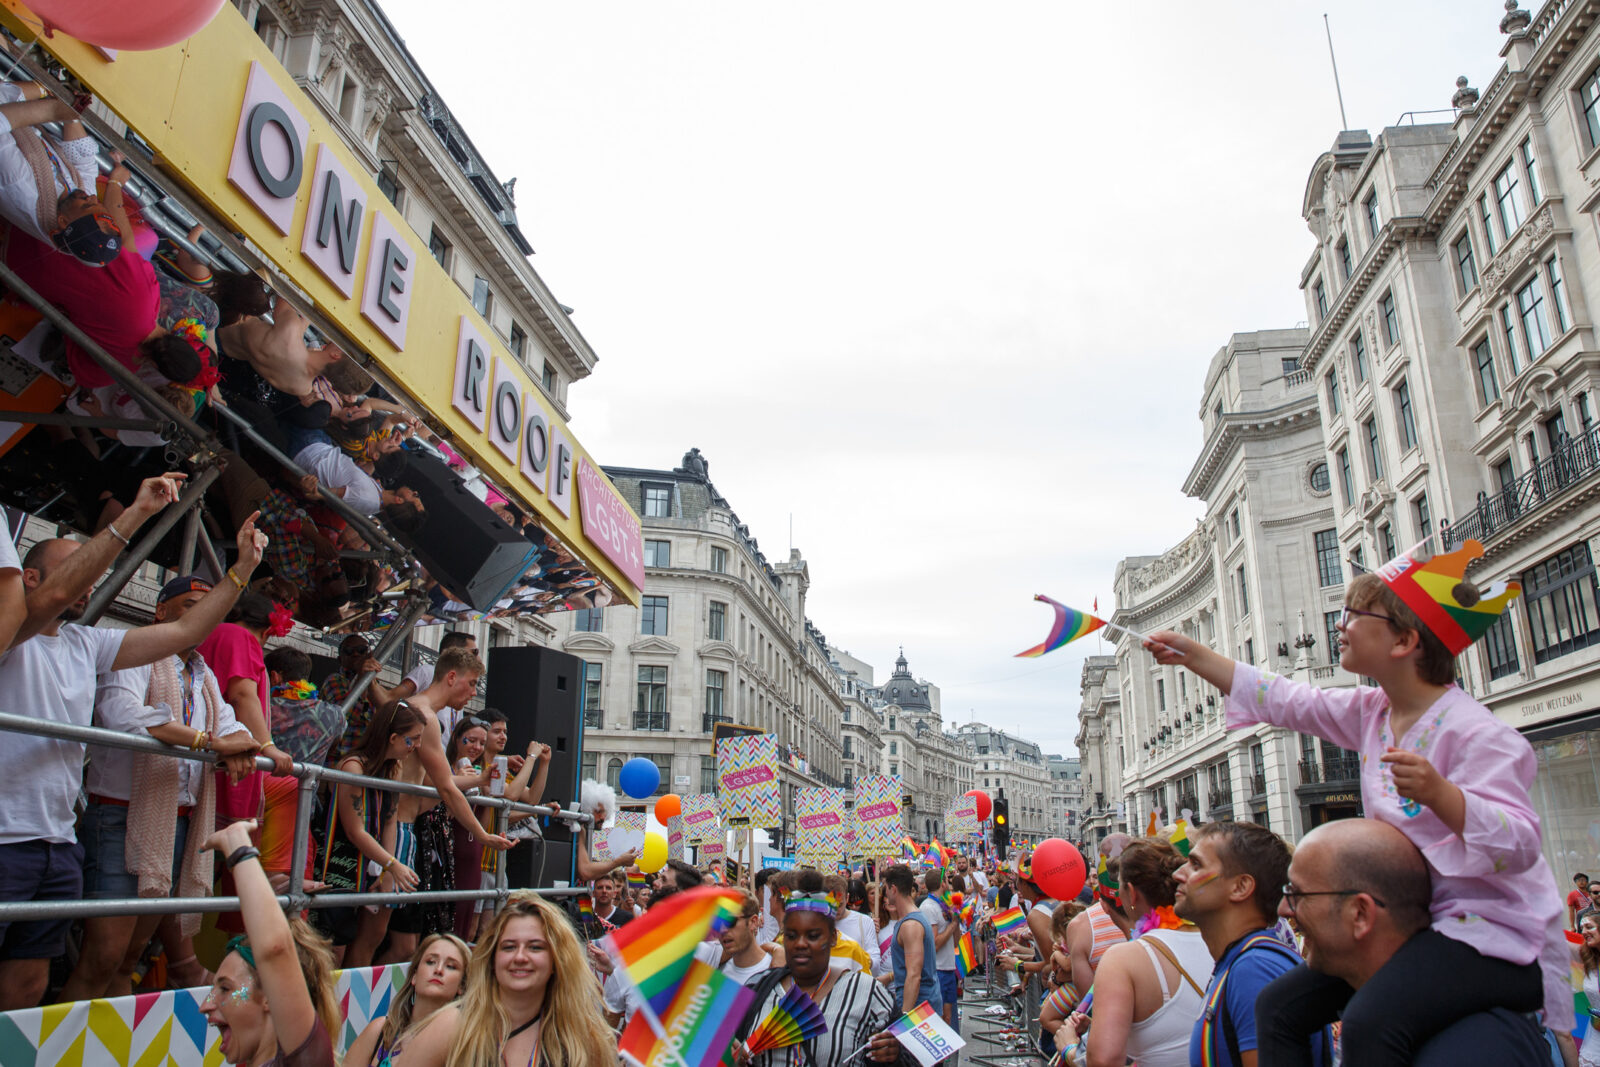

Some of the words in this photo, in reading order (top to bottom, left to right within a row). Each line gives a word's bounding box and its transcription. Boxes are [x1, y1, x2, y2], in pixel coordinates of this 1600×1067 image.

[247, 101, 408, 323] ONE
[464, 338, 570, 495] ROOF
[581, 465, 639, 540] ARCHITECTURE
[1521, 702, 1544, 717] STUART
[1545, 692, 1583, 711] WEITZMAN
[726, 772, 768, 788] LGBT+
[668, 984, 713, 1036] Tinto
[917, 1022, 954, 1055] PRIDE
